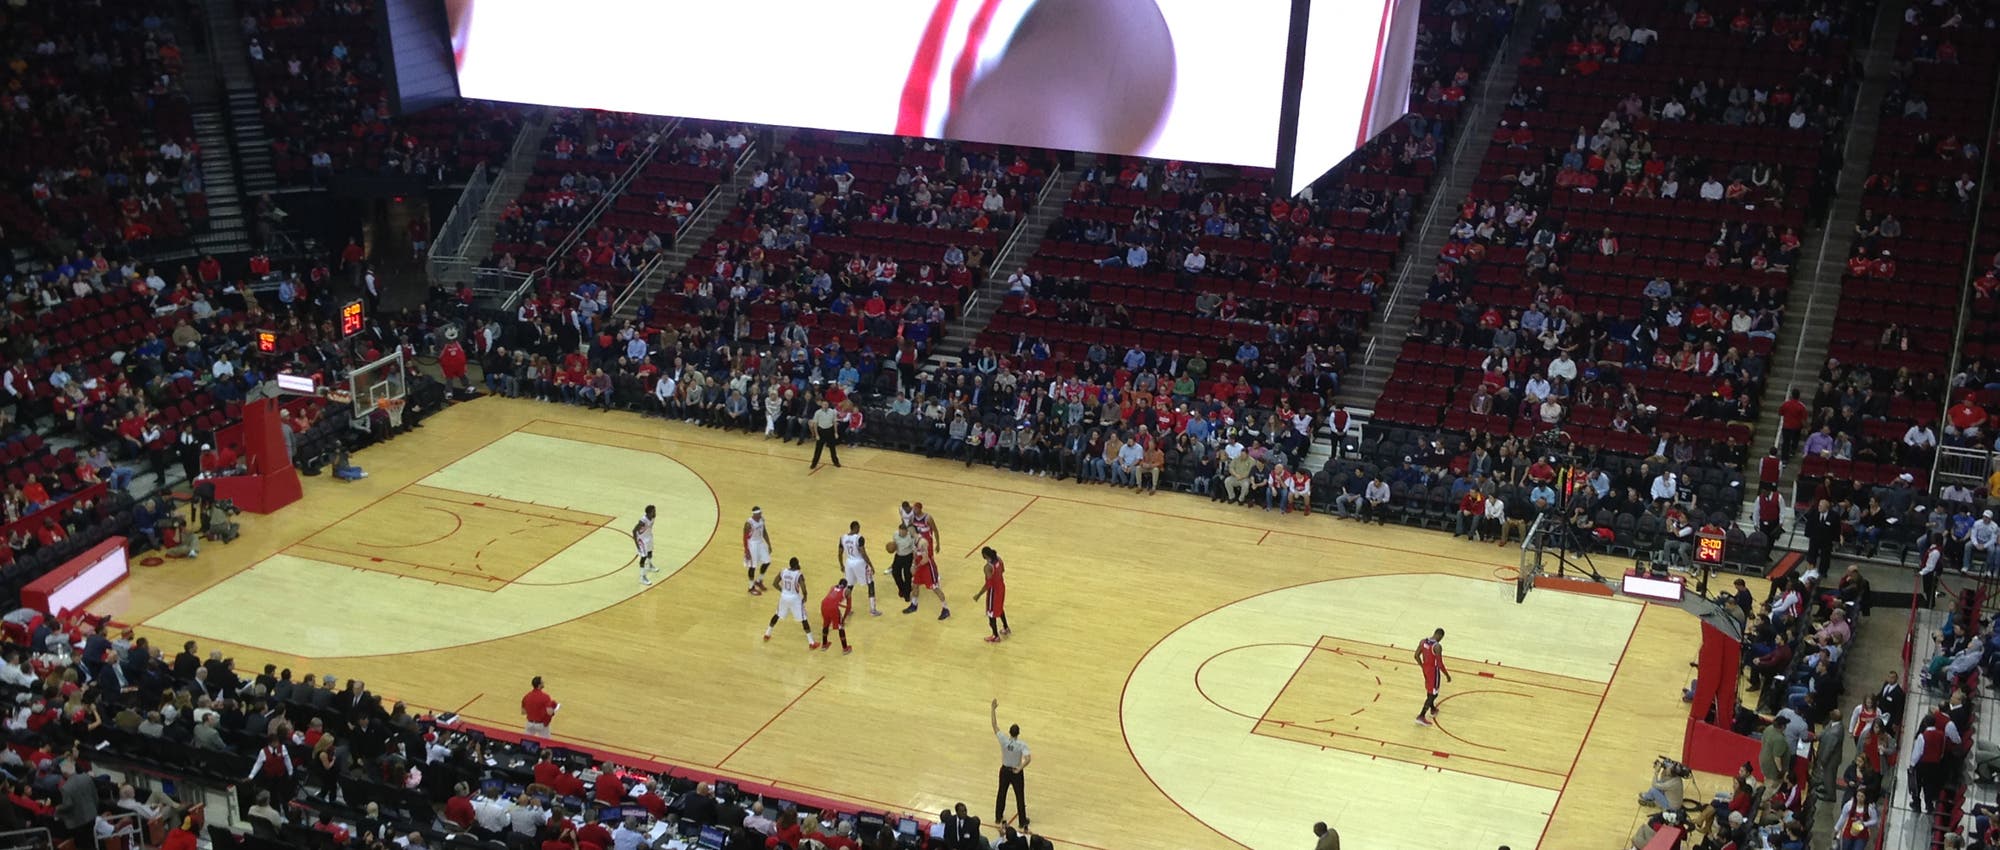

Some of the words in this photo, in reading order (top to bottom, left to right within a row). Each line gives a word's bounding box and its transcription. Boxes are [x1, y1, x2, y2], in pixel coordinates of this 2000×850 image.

[344, 314, 360, 334] 24
[1700, 538, 1721, 549] 12:00
[1700, 547, 1717, 559] 24
